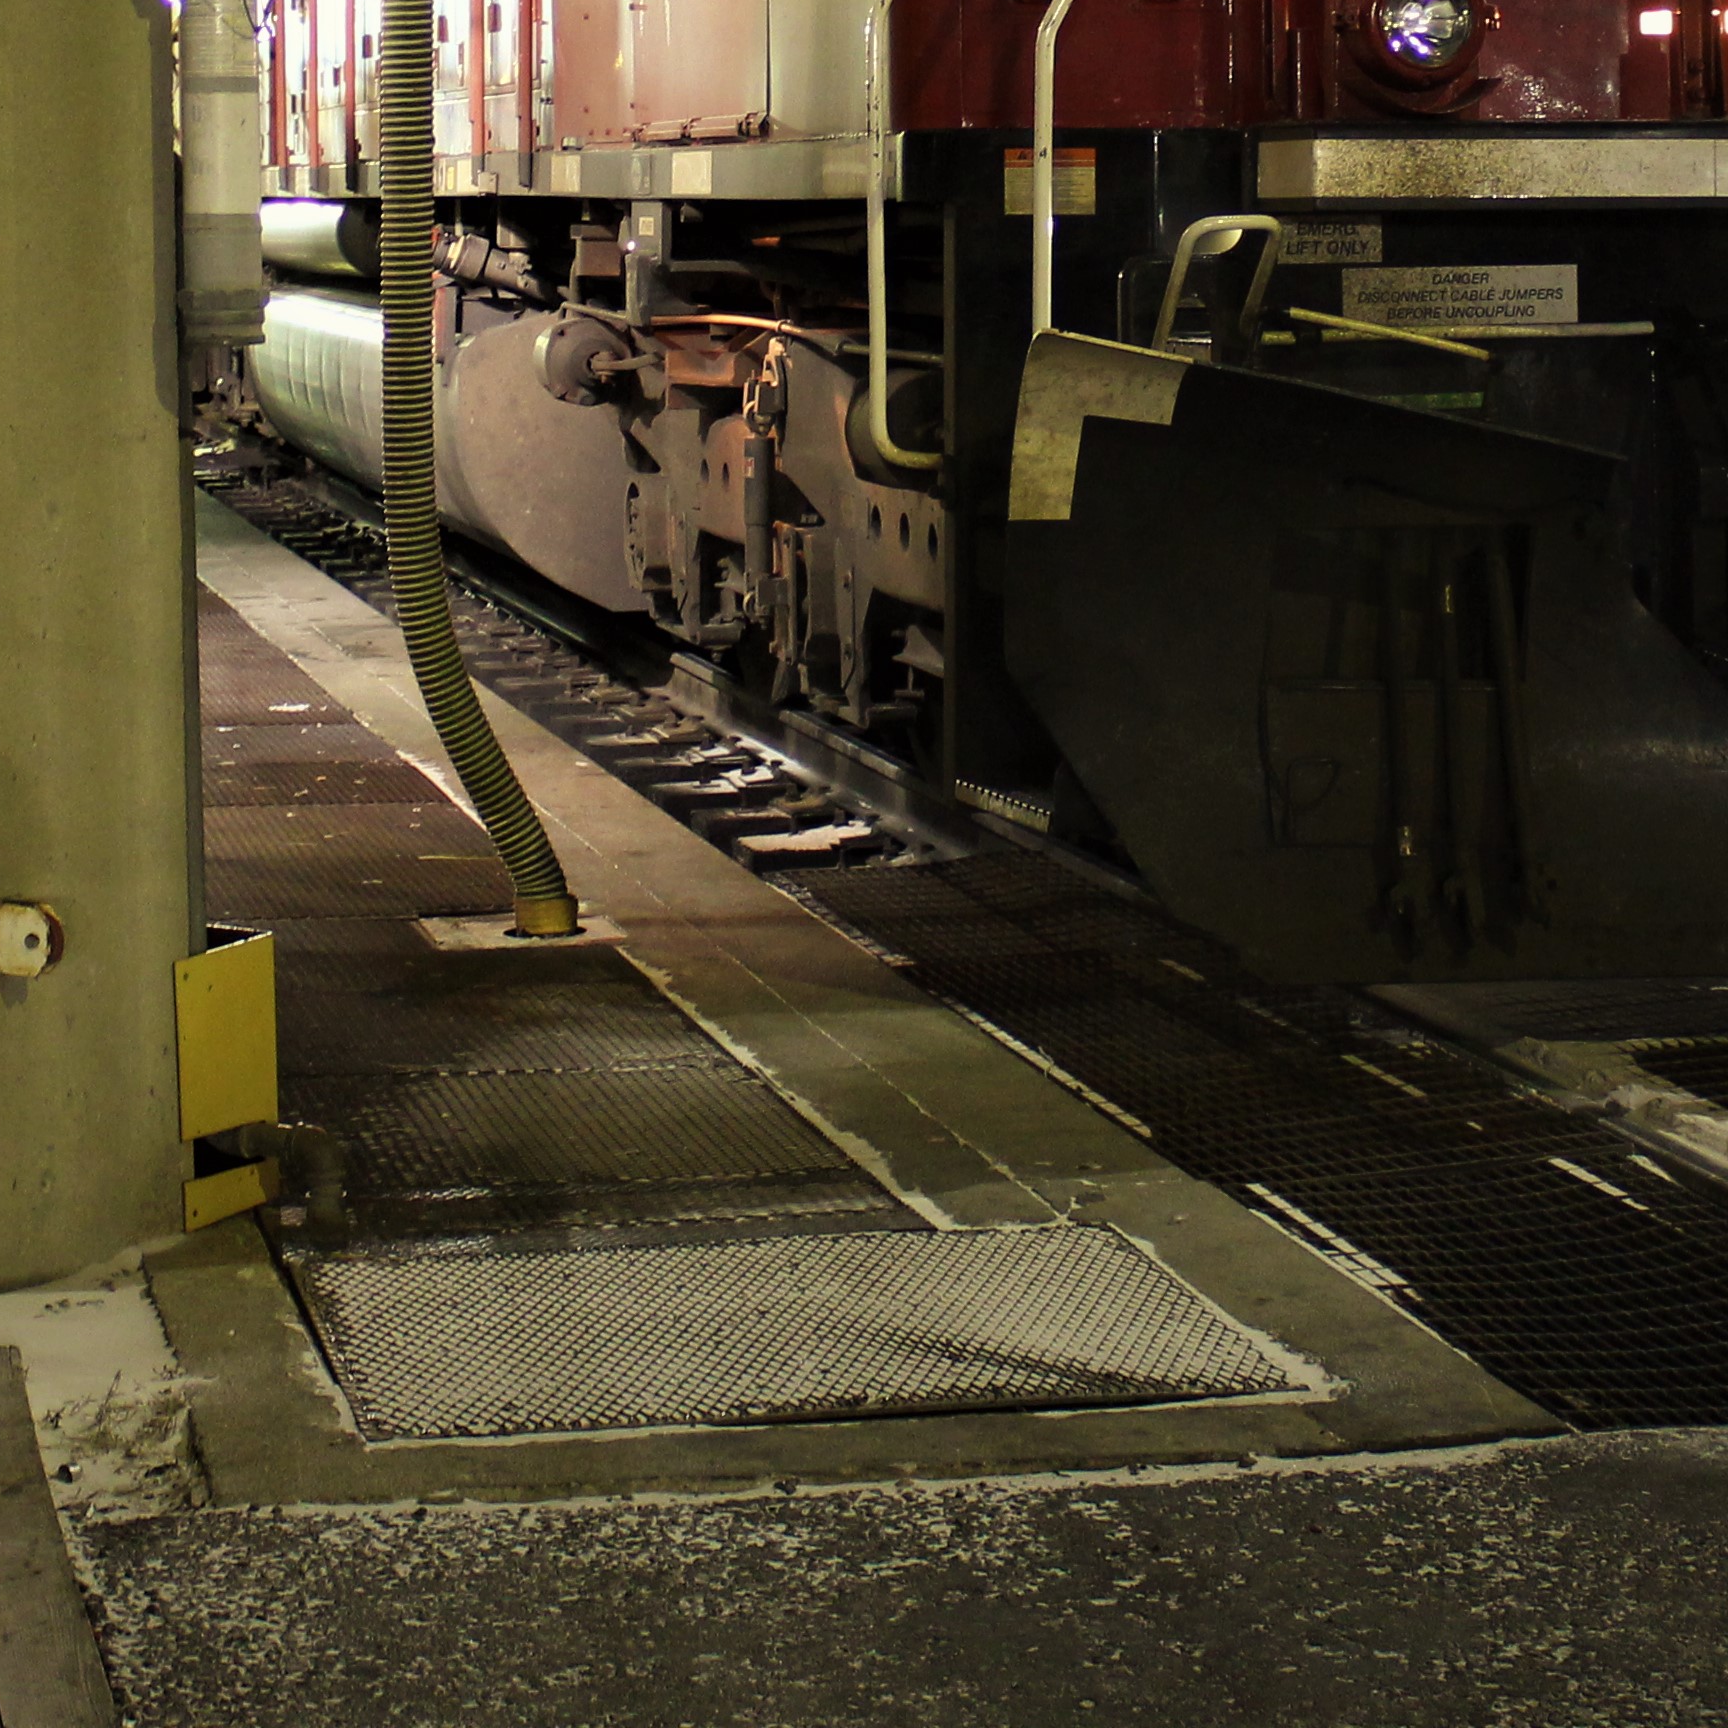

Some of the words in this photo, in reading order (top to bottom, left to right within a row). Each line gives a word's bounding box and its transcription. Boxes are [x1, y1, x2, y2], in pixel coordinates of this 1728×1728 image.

[1285, 240, 1322, 256] LIFT
[1326, 239, 1370, 257] ONLY
[1431, 272, 1490, 286] DANGER
[1357, 291, 1447, 304] DISCONNECT
[1450, 288, 1495, 302] CABLE
[1497, 286, 1564, 302] JUMPERS
[1385, 306, 1442, 320] BEFORE
[1445, 304, 1536, 319] UNCOUPLING
